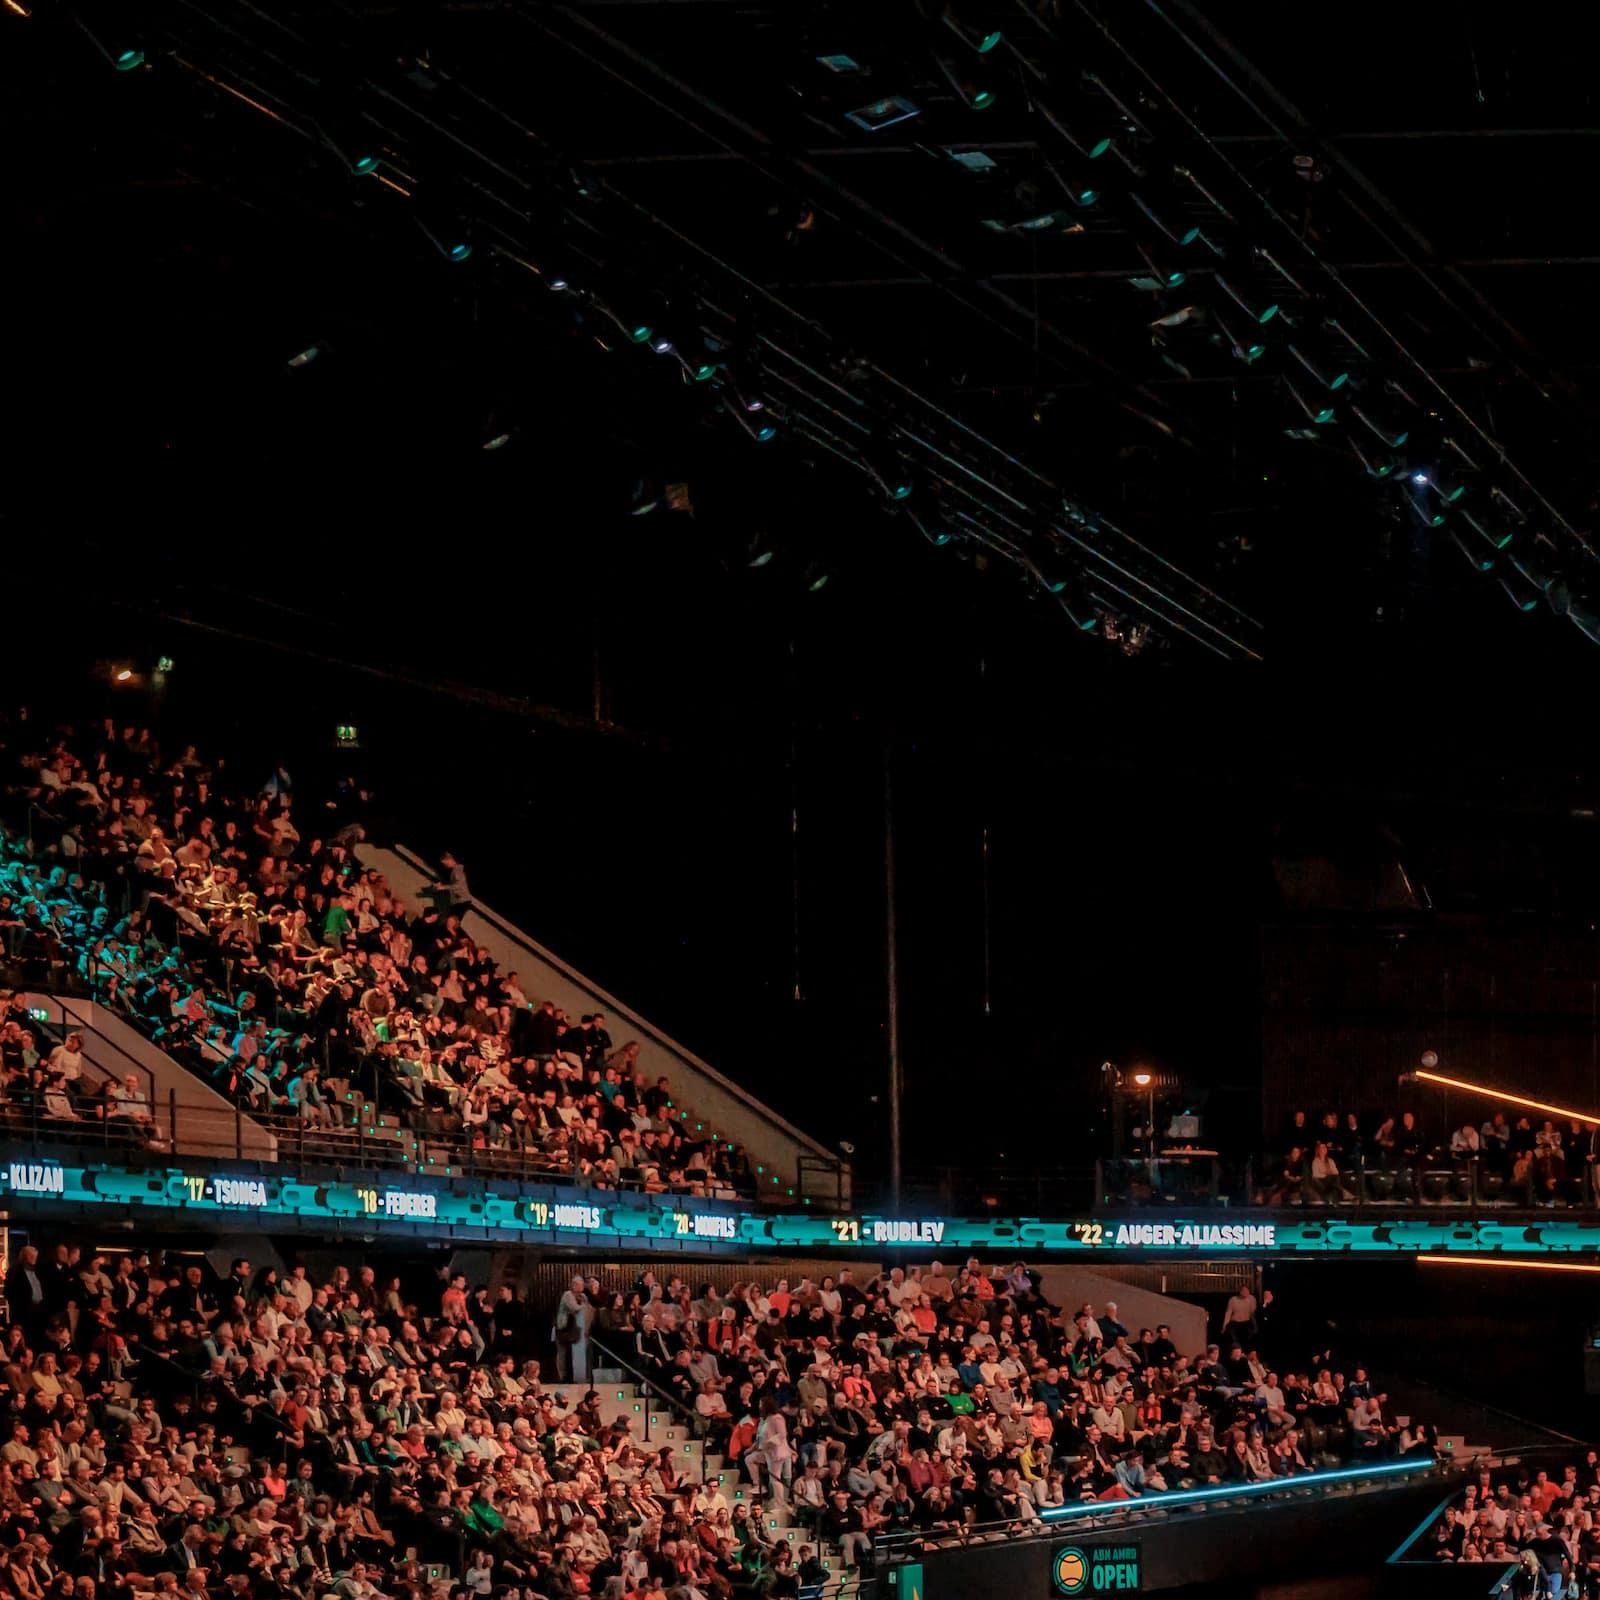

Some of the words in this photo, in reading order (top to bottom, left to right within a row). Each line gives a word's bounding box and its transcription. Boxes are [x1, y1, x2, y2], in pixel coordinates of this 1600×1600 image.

[10, 1164, 64, 1193] KLIZAN
[214, 1179, 267, 1206] TSONGA
[357, 1189, 378, 1213] '18
[385, 1192, 437, 1218] FEDERER
[554, 1204, 600, 1229] MONFILS
[831, 1220, 858, 1241] '21
[874, 1221, 945, 1242] RUBLEV
[1074, 1224, 1102, 1244] '22
[1116, 1224, 1275, 1246] AUGER-ALIASSIME
[1093, 1565, 1138, 1589] OPEN
